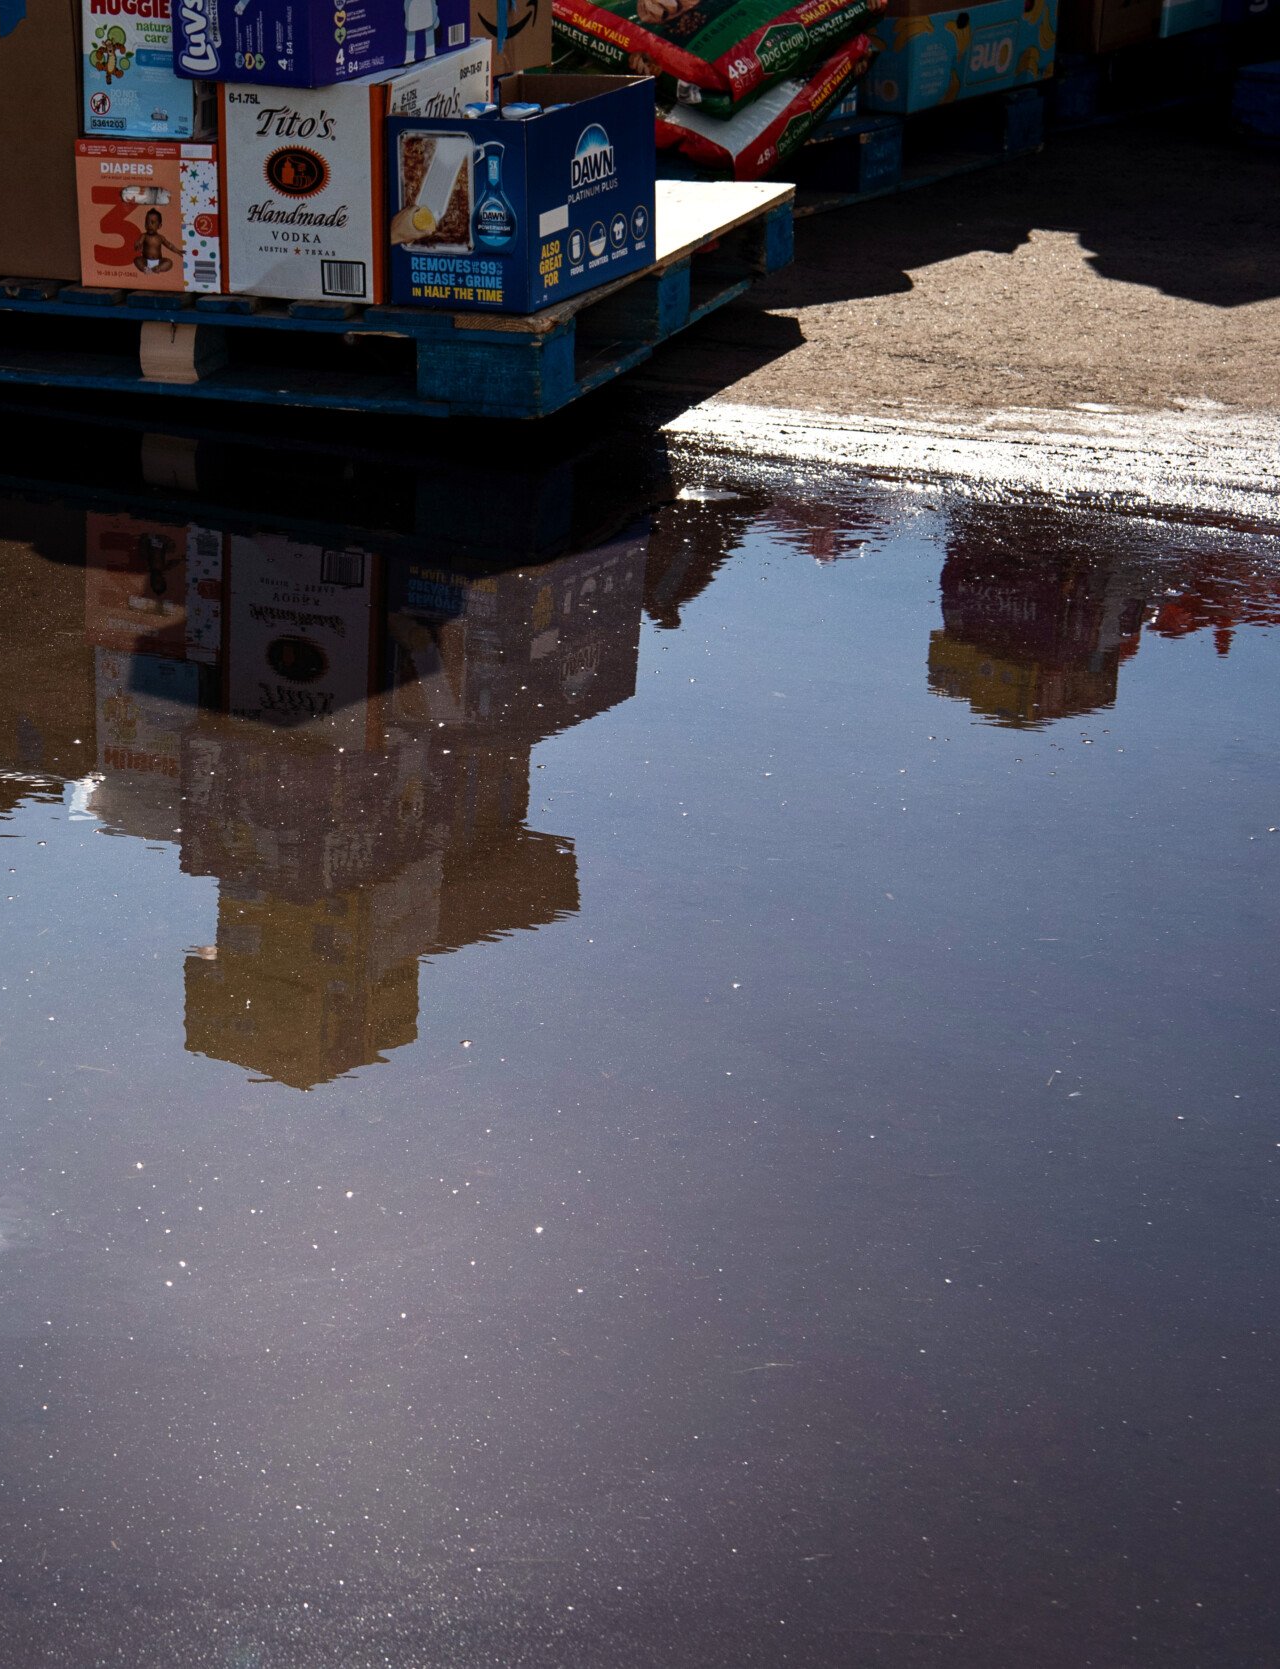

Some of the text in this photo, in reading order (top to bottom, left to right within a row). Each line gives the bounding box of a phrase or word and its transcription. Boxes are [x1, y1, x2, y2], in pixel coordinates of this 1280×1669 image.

[91, 0, 171, 18] HUGGIE
[136, 22, 173, 33] natura
[210, 0, 219, 42] protectio
[809, 15, 844, 38] COMPLETE
[844, 2, 867, 20] ADULT
[145, 33, 169, 43] care
[572, 13, 603, 33] SMART
[604, 27, 630, 48] VALUE
[552, 19, 589, 46] MPLETE
[590, 39, 624, 61] ADULT
[761, 47, 781, 67] DOG
[780, 31, 805, 53] CHOW
[277, 58, 288, 71] 4
[336, 48, 345, 65] 4
[348, 60, 358, 73] 84
[734, 72, 757, 92] SIZE
[229, 93, 261, 104] 6-1.75L
[425, 87, 461, 118] Tito's
[256, 105, 337, 140] Tito's
[100, 162, 153, 175] DIAPERS
[571, 147, 614, 189] DAWN
[567, 178, 618, 204] PLATINUM PLUS
[247, 200, 348, 228] Handmade
[482, 212, 506, 221] DAWN
[91, 186, 142, 266] 3
[200, 219, 208, 231] 2
[272, 231, 321, 244] VODKA
[541, 240, 560, 259] ALSO
[411, 256, 471, 274] REMOVES
[539, 254, 562, 275] GREAT
[411, 271, 455, 285] GREASE
[465, 274, 503, 289] GRIME
[544, 271, 558, 288] FOR
[412, 285, 503, 302] IN HALF THE TIME
